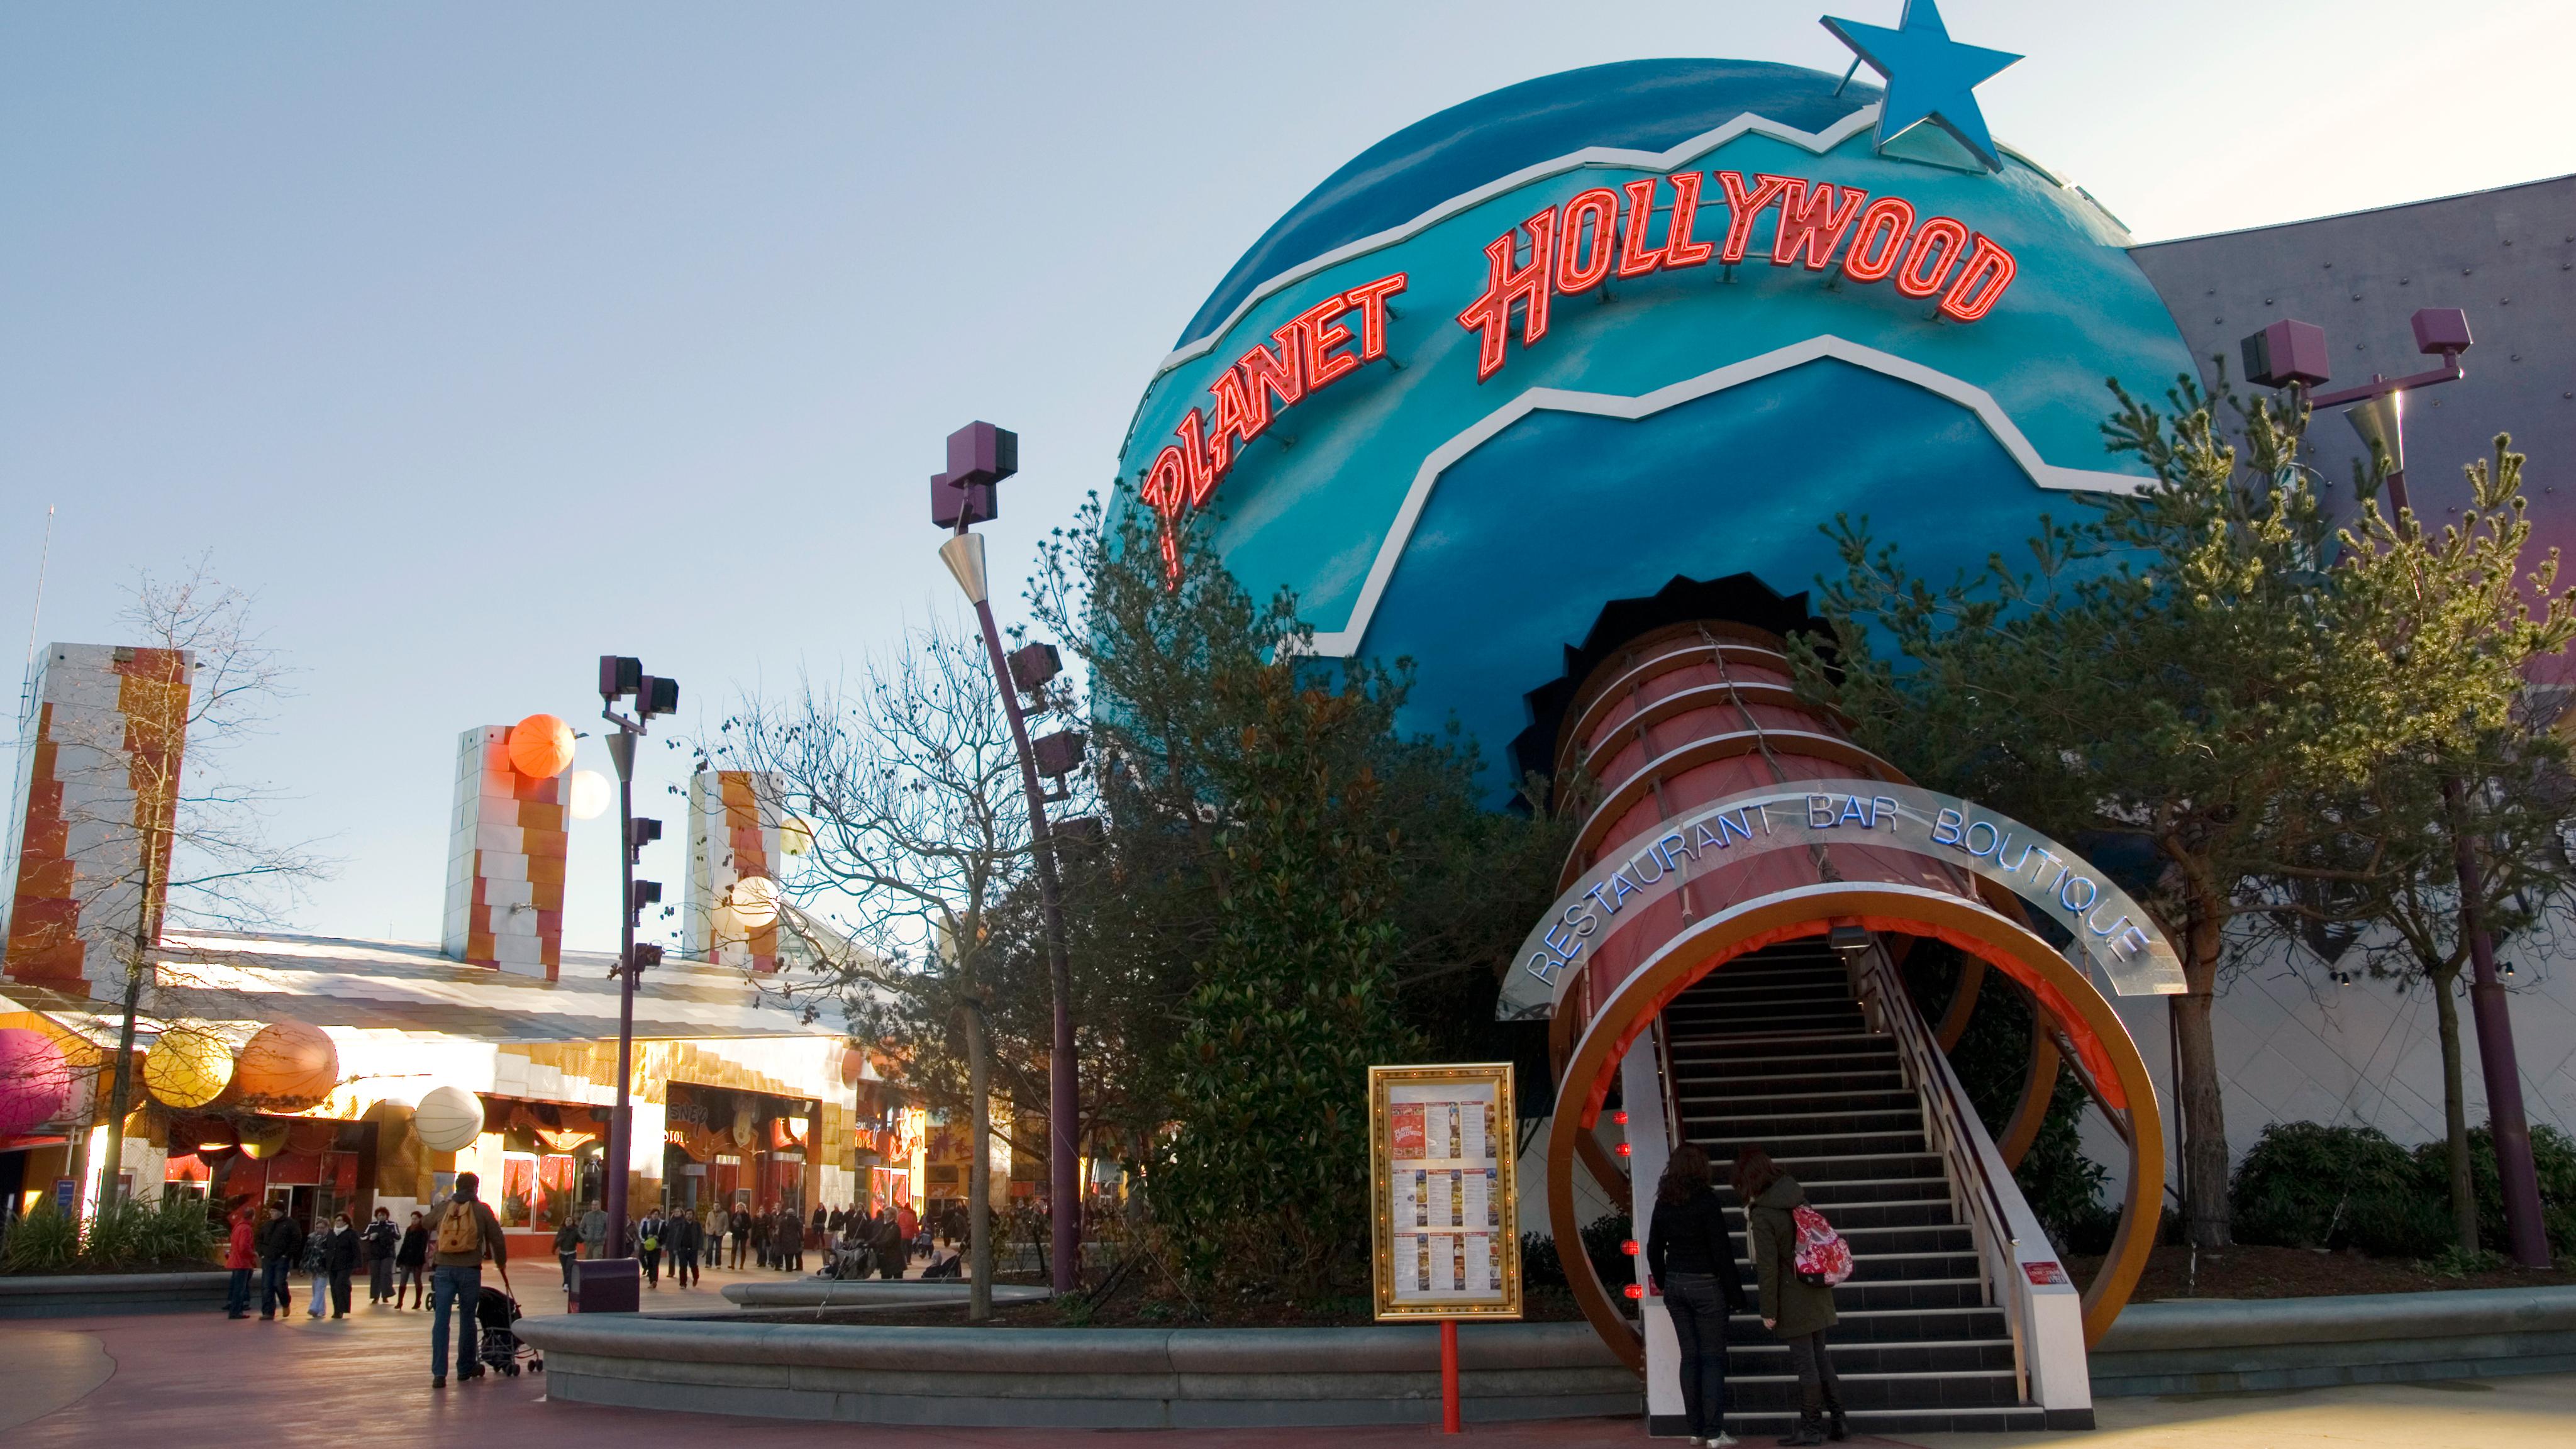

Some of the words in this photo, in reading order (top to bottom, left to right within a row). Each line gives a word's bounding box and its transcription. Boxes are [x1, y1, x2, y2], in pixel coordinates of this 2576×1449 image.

[1140, 272, 1409, 592] PLANET
[1456, 170, 2018, 384] HOLLYWOOD
[1526, 801, 1772, 987] RESTAURANT
[1807, 794, 1899, 833] BAR
[1931, 808, 2150, 963] BOUTIQUE
